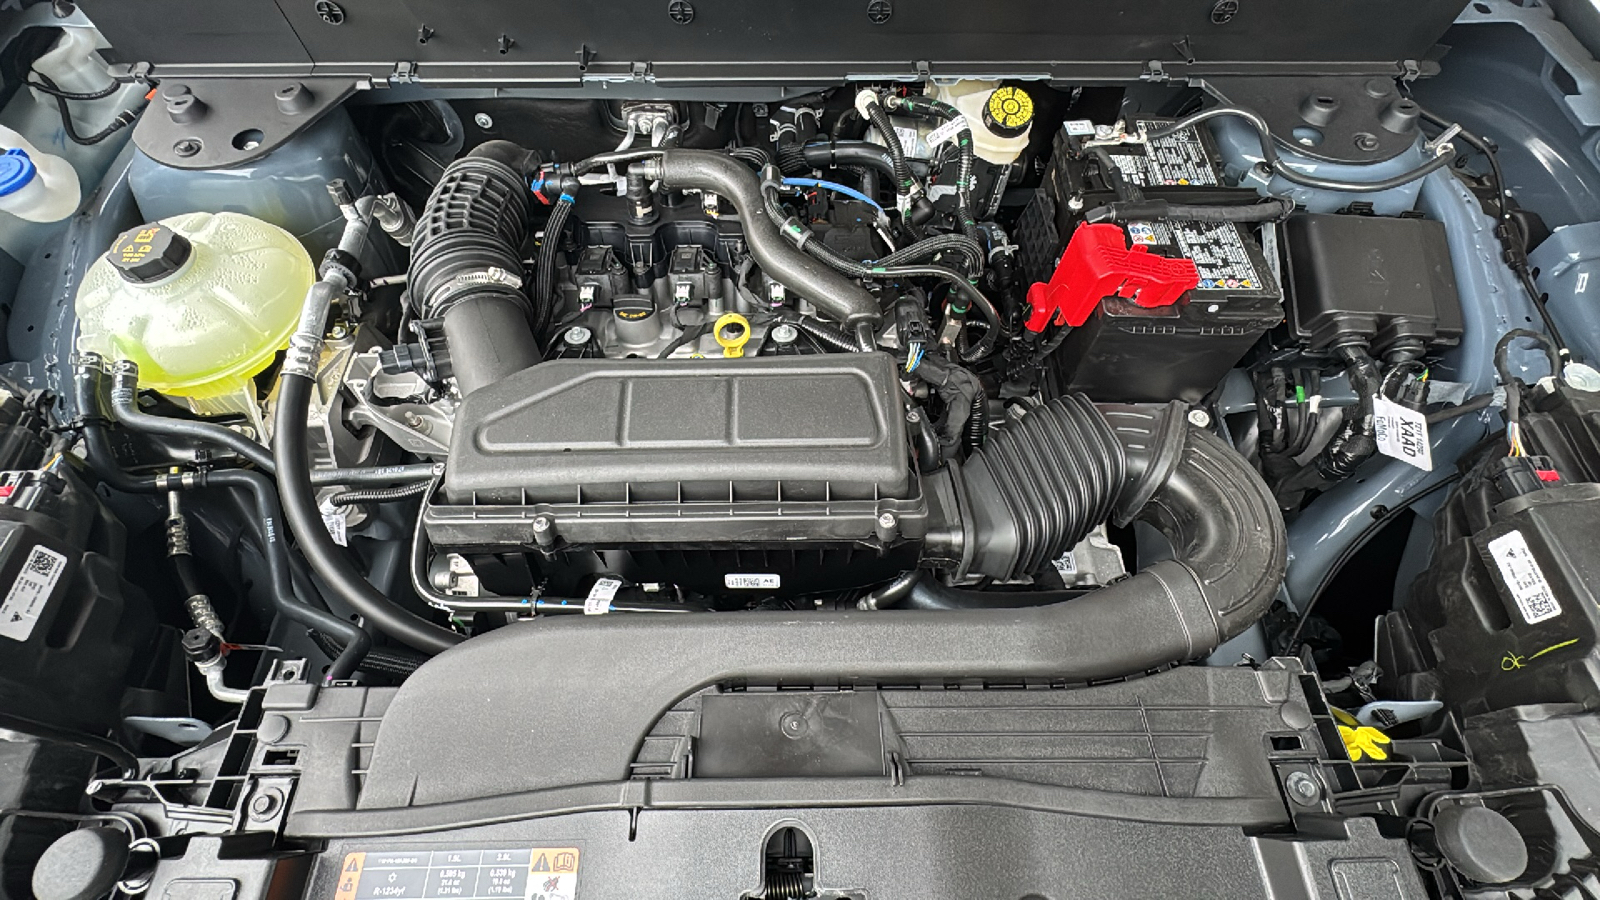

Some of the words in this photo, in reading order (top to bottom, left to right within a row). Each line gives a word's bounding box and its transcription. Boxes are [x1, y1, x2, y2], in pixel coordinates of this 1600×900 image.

[1376, 415, 1388, 442] FoMoCo
[1399, 416, 1417, 457] XAAD
[1501, 650, 1526, 671] OK
[457, 869, 466, 880] kg
[507, 867, 516, 879] kg
[372, 886, 406, 897] R-1234yf
